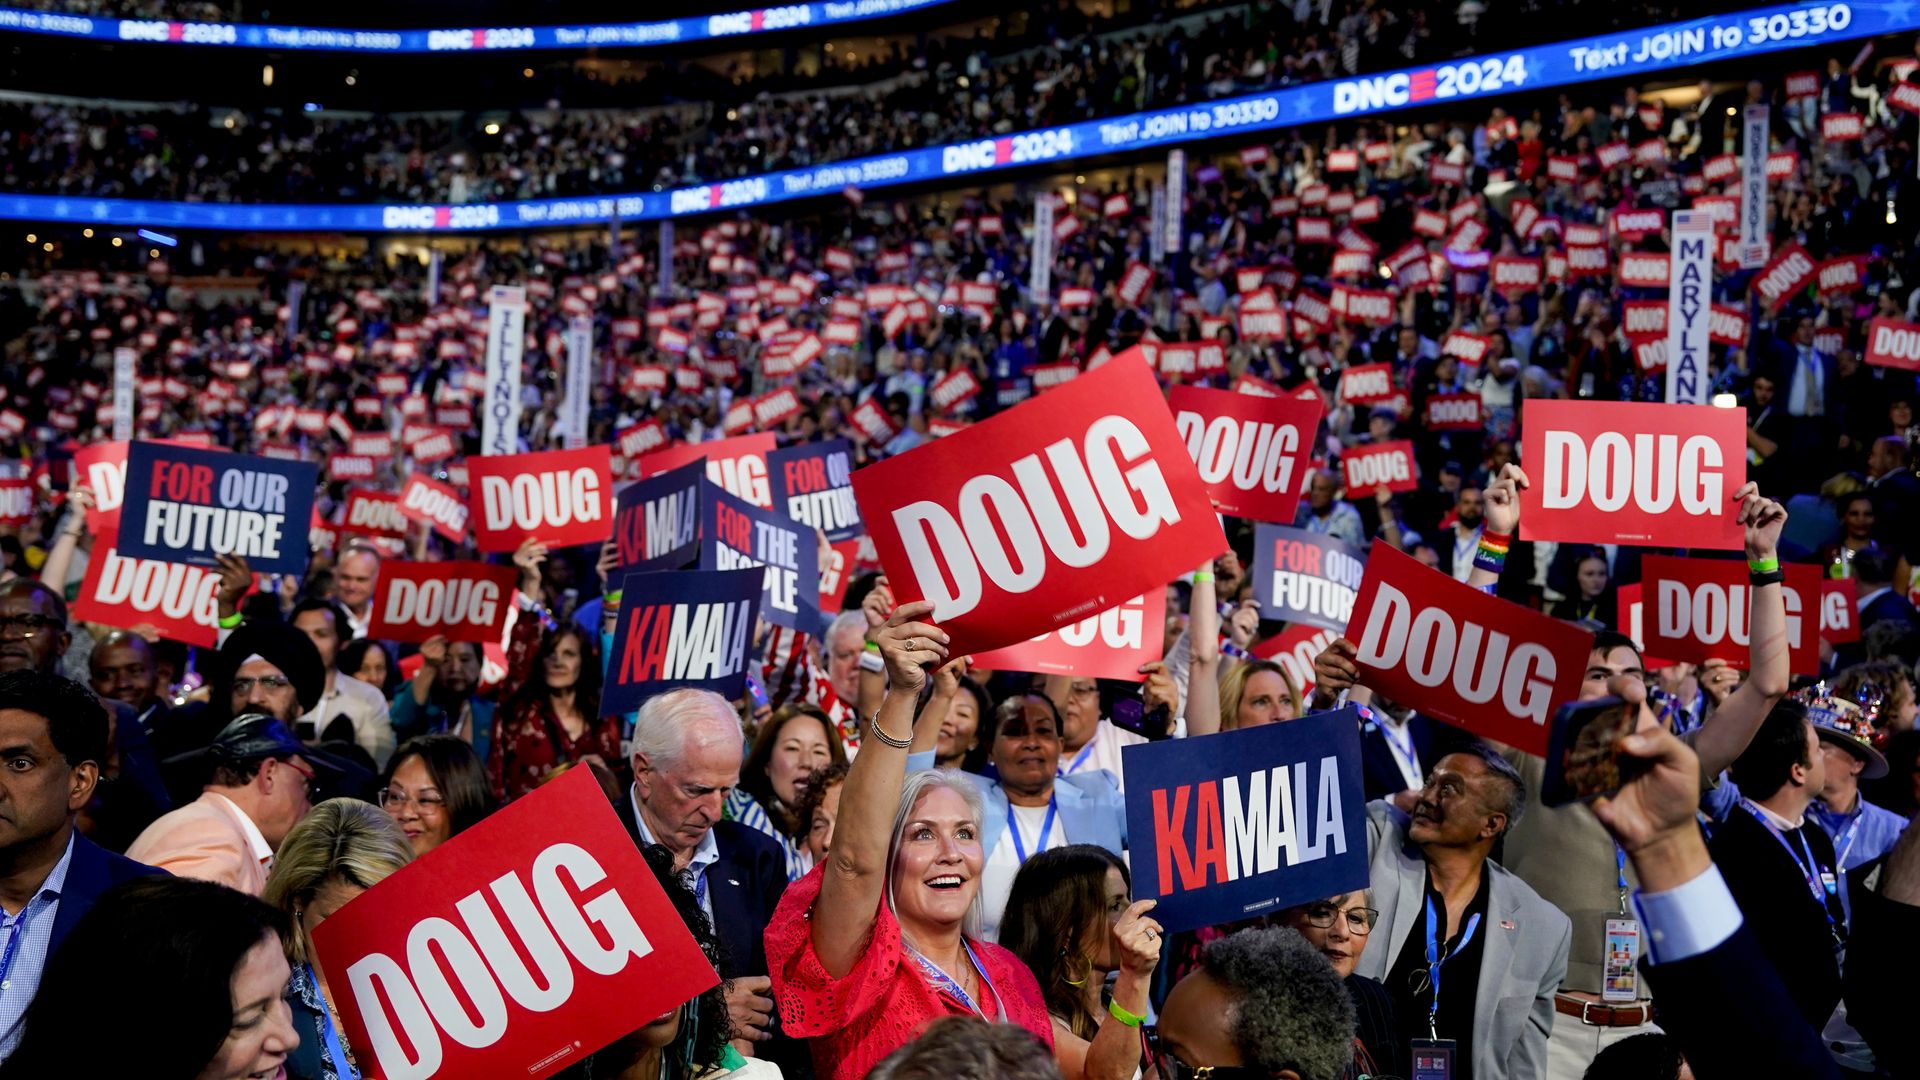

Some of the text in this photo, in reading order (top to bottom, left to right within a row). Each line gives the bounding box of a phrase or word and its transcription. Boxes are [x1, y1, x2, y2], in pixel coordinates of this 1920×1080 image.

[1570, 4, 1852, 72] Text JOIN to 30330
[1433, 54, 1528, 99] 2024
[1011, 128, 1073, 162] 2024
[1100, 98, 1279, 145] Text JOIN to 30330
[1758, 252, 1814, 300] DOUG
[1675, 239, 1705, 405] MARYLAN
[492, 310, 515, 454] ILLINOIS
[784, 451, 850, 496] FOR OU
[1176, 410, 1300, 494] DOUG
[1347, 451, 1410, 488] DOUG
[1542, 430, 1723, 516] DOUG
[150, 459, 214, 505] FOR
[219, 468, 289, 514] OUR
[404, 480, 469, 534] DOUG
[481, 467, 602, 531] DOUG
[891, 414, 1181, 624] DOUG
[143, 499, 286, 560] FUTURE
[617, 485, 696, 568] KAMALA
[716, 500, 798, 571] FOR THE
[95, 548, 223, 629] DOUG
[1272, 569, 1359, 624] FUTUR
[1274, 539, 1364, 592] FOR OUR
[384, 578, 499, 627] DOUG
[1658, 578, 1802, 649] DOUG
[617, 599, 751, 685] KAMALA
[1356, 581, 1557, 726] DOUG
[1151, 755, 1348, 897] KAMALA
[346, 842, 655, 1080] DOUG
